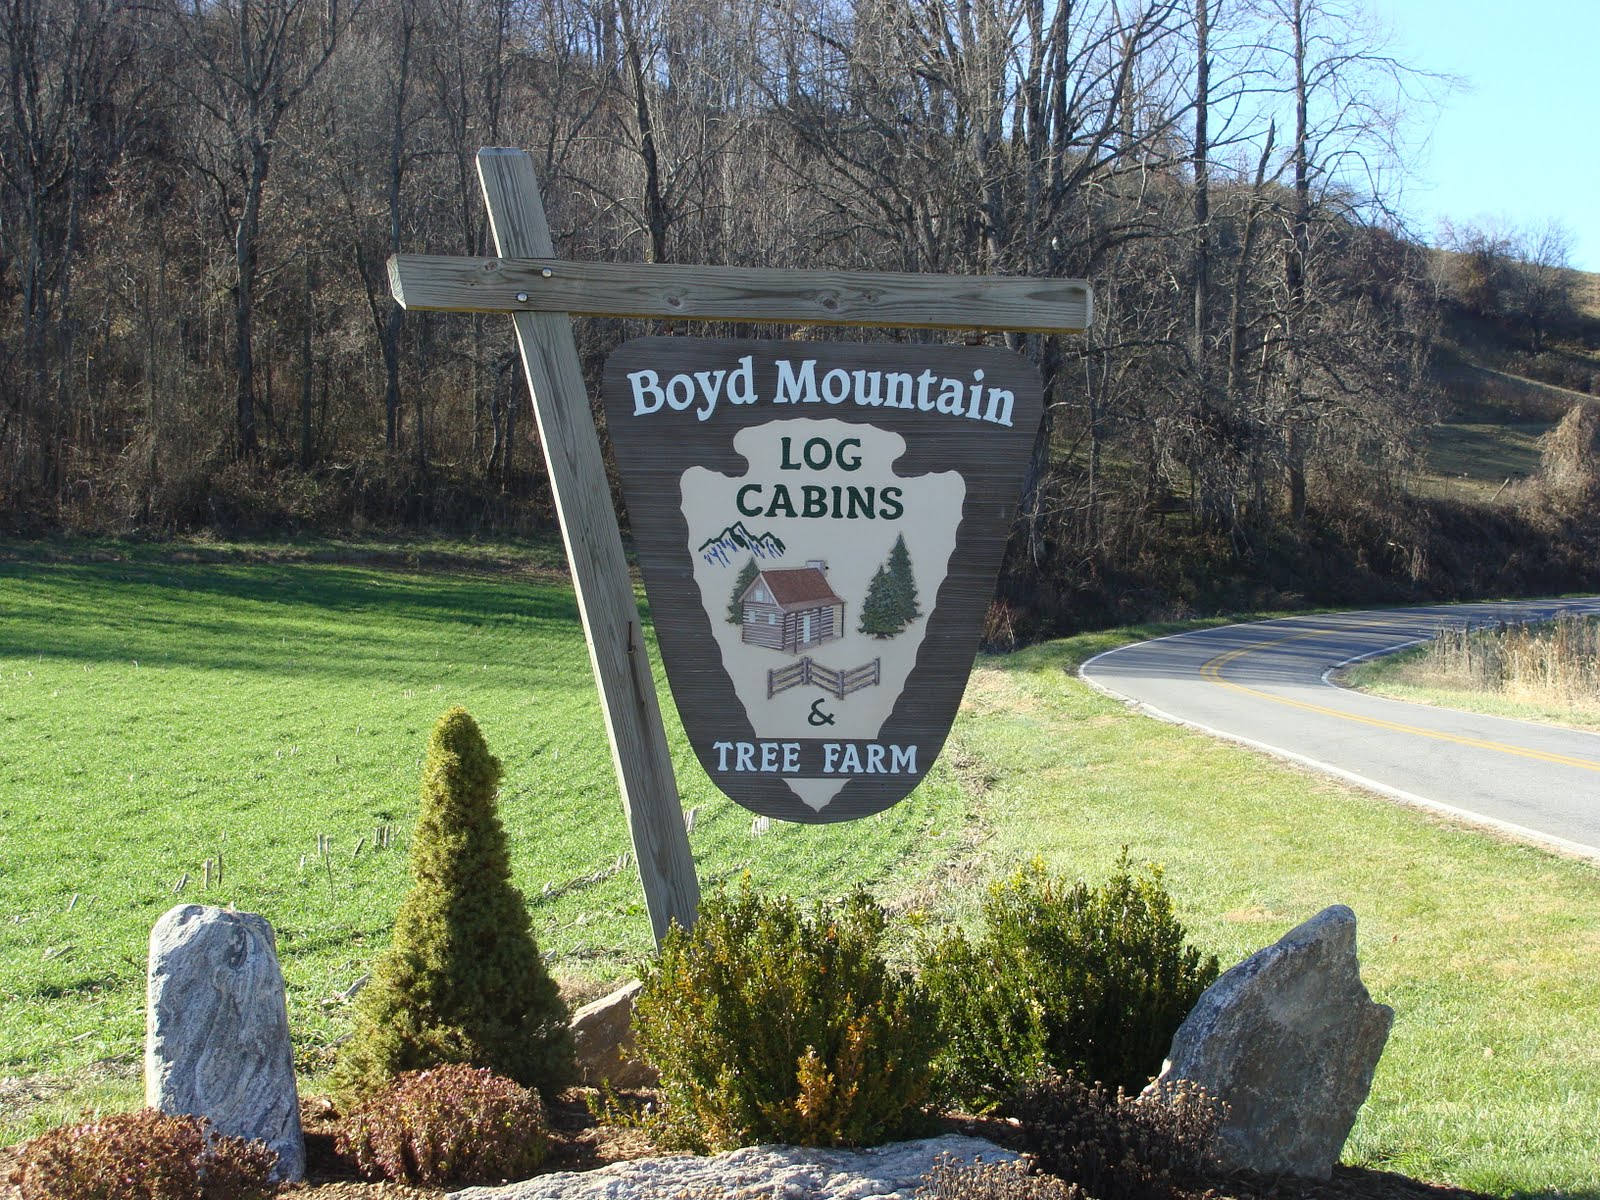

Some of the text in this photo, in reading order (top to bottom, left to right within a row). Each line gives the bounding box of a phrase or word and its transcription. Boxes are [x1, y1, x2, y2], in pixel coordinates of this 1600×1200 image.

[627, 355, 1016, 428] Boyd Mountain
[779, 436, 863, 471] LOG
[736, 484, 905, 520] CABINS
[807, 698, 835, 726] &
[712, 741, 918, 774] TREE FARM
